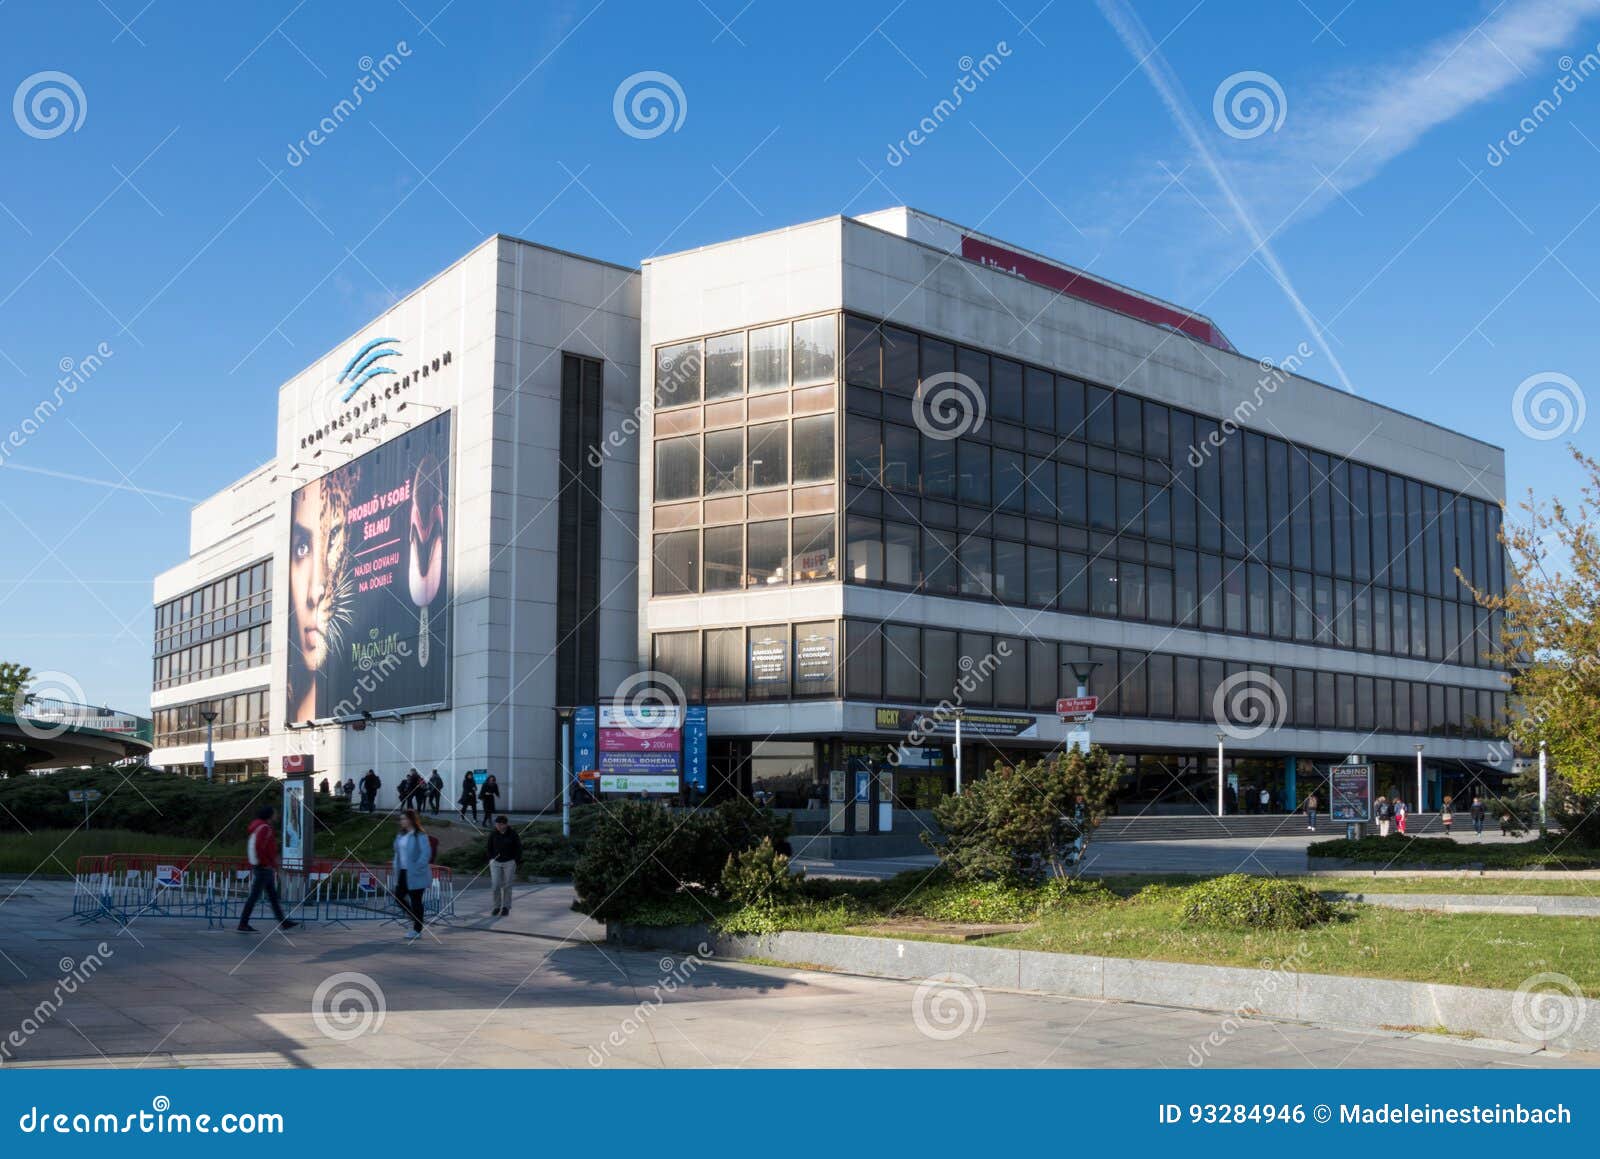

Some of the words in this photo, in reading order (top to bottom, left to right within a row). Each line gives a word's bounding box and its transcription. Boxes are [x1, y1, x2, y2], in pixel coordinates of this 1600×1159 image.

[384, 350, 452, 400] CENTRUM
[347, 494, 379, 525] PROBUĎ
[379, 494, 387, 510] V
[387, 479, 410, 507] SOBĚ
[363, 515, 391, 541] ŠELMU
[372, 552, 400, 571] ODVAHU
[359, 581, 368, 593] NA
[351, 632, 400, 663] MAGNUM
[877, 709, 900, 724] ROCKY
[580, 747, 589, 756] 10
